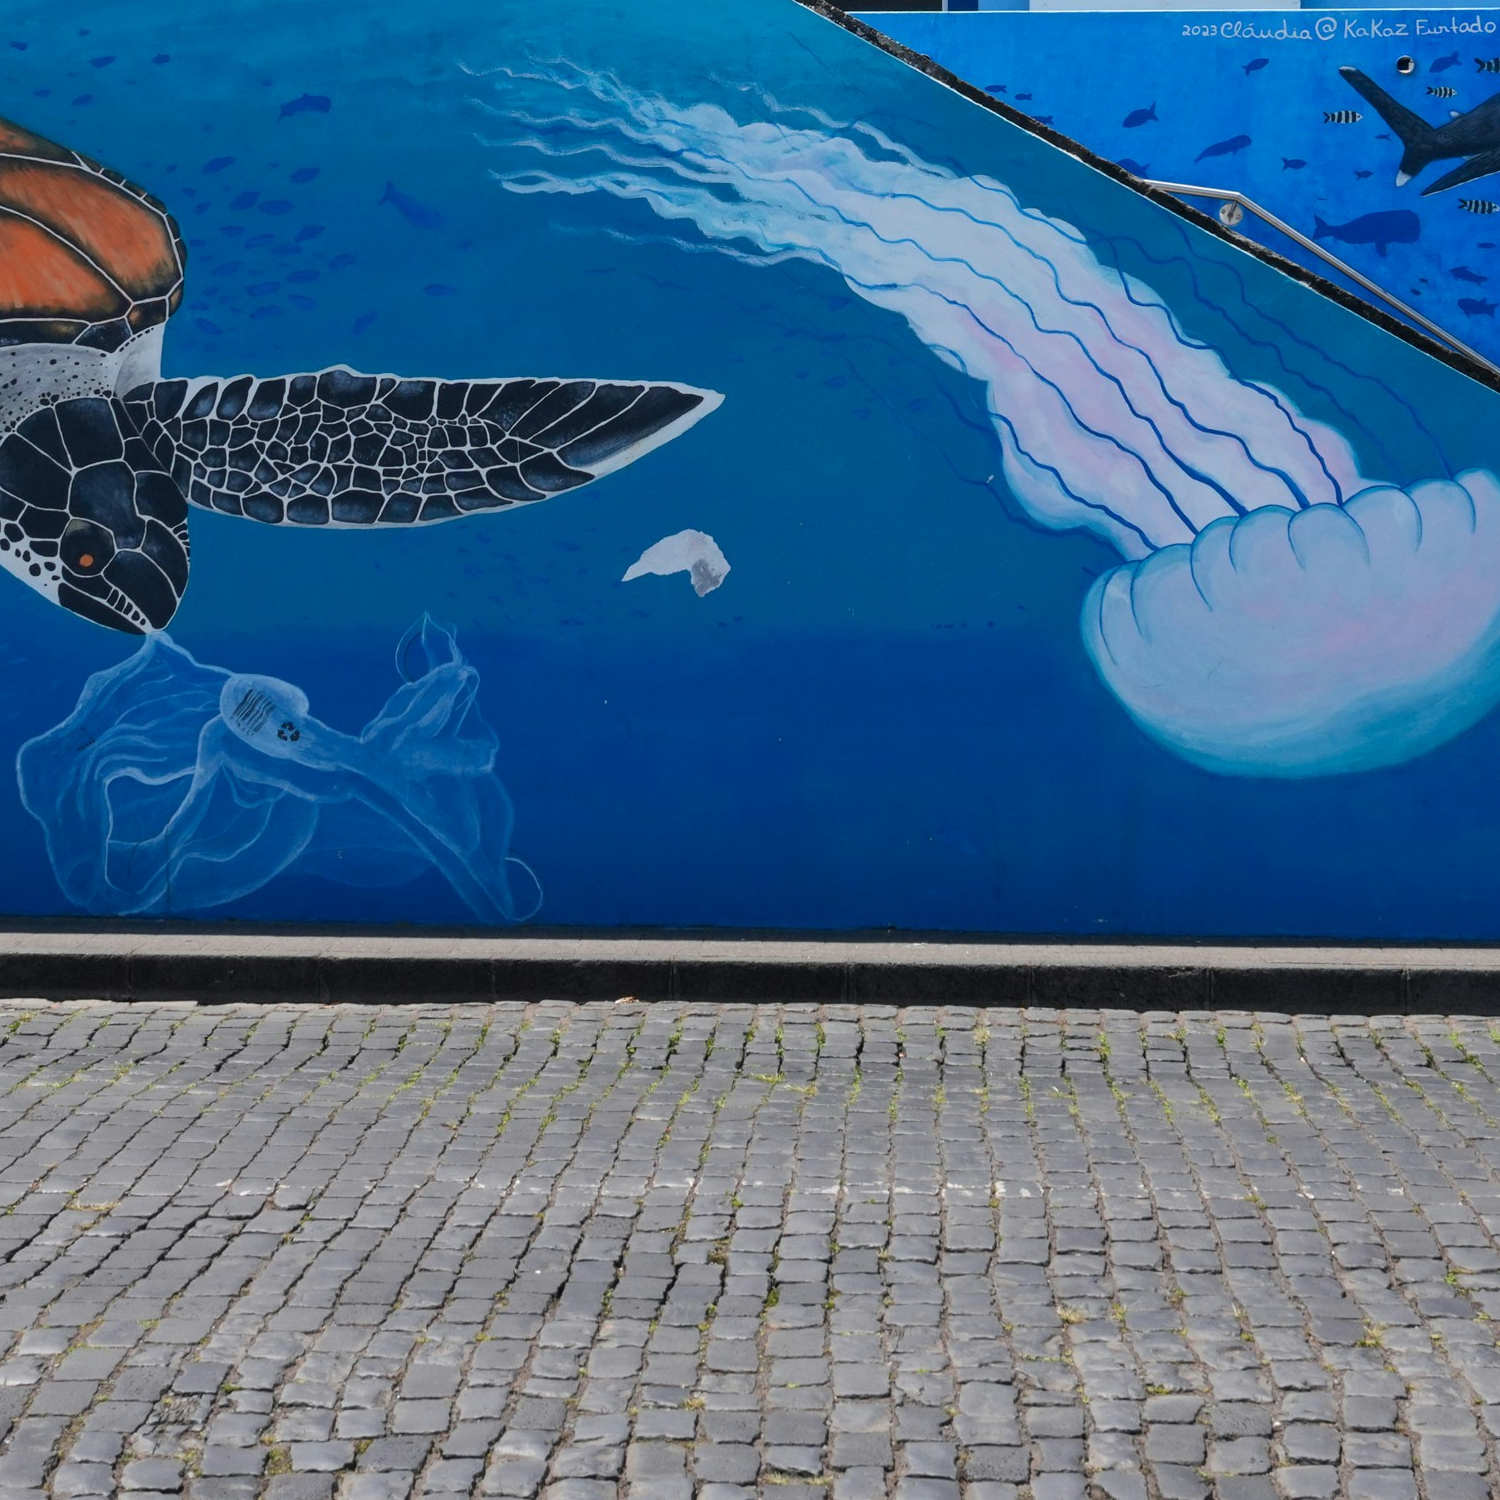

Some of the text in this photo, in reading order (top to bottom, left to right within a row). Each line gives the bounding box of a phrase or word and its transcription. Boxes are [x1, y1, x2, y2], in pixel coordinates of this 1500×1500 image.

[1181, 24, 1218, 37] 2023
[1220, 19, 1313, 41] Cláudia
[1415, 15, 1497, 36] Furtado
